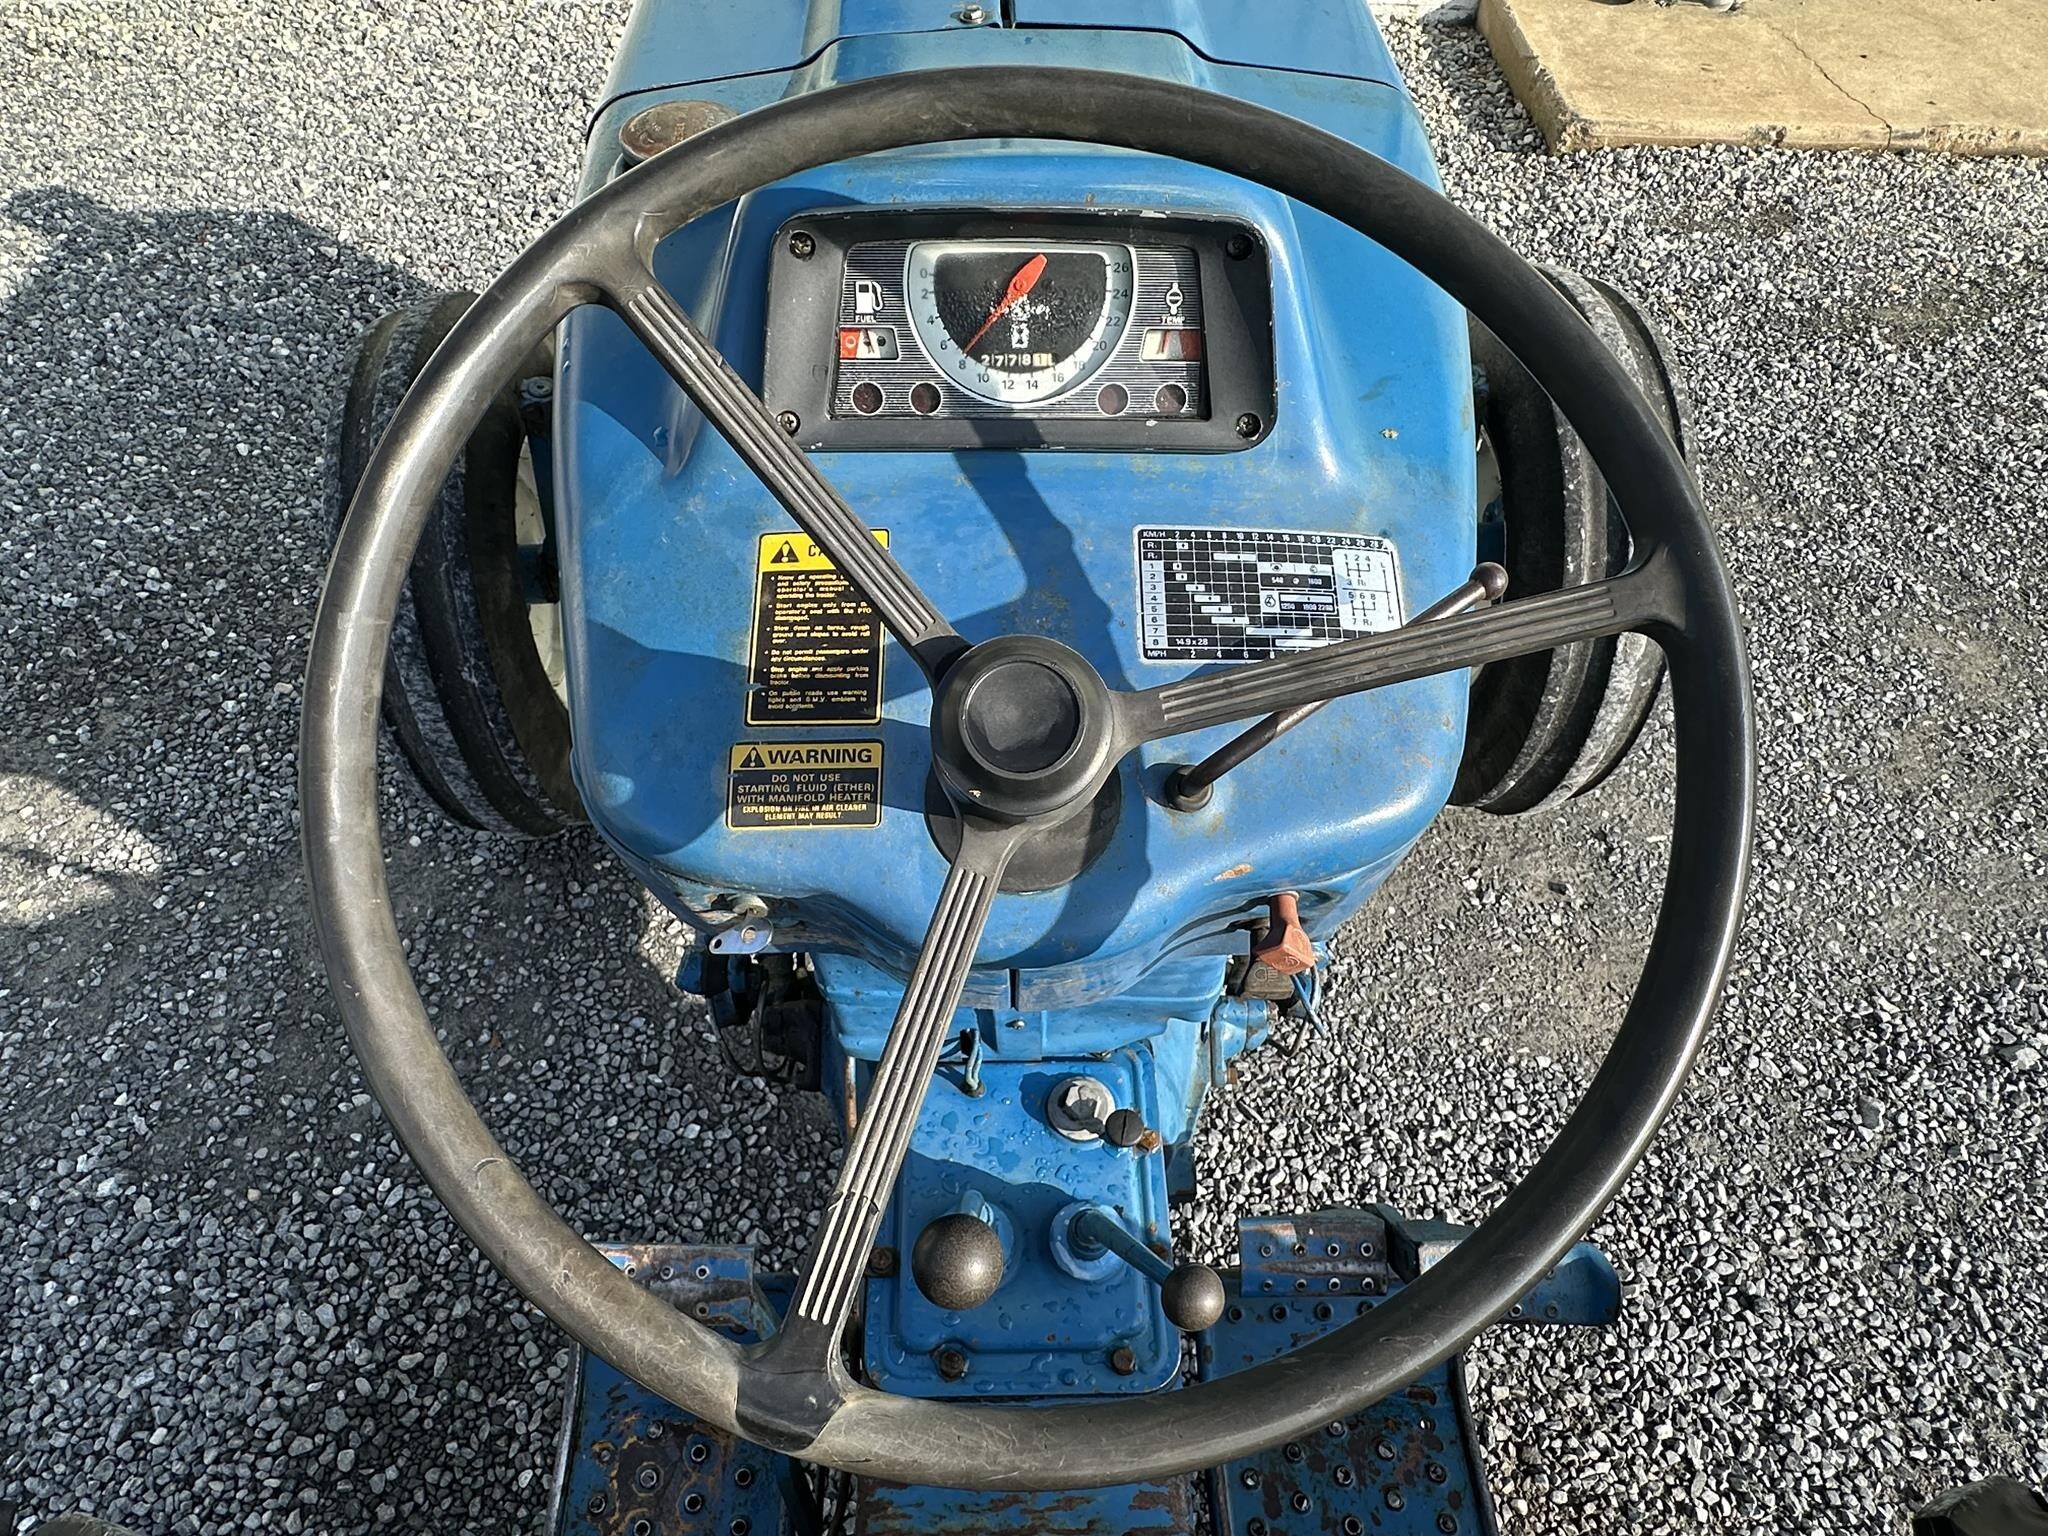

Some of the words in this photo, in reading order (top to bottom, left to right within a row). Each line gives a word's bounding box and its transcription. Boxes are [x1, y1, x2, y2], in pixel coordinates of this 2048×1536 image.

[1113, 262, 1129, 273] 26
[920, 268, 928, 278] 0
[921, 289, 928, 299] 2
[1112, 289, 1128, 299] 24
[855, 315, 876, 323] FUEL
[927, 315, 934, 325] 4
[1106, 317, 1120, 327] 22
[1160, 316, 1185, 325] TEMP
[940, 340, 947, 350] 6
[1094, 341, 1107, 351] 20
[959, 360, 966, 369] 8
[977, 373, 989, 382] 10
[1052, 373, 1064, 382] 16
[1002, 380, 1015, 389] 12
[1026, 380, 1038, 389] 14
[768, 748, 872, 764] WARNING
[772, 775, 787, 783] DO
[793, 774, 815, 782] NOT
[738, 785, 790, 793] STARTING
[797, 784, 828, 792] FLUID
[833, 783, 875, 792] (ETHER)
[737, 795, 765, 803] WITH
[769, 794, 825, 802] MANIFOLD
[830, 793, 873, 801] HEATER.
[765, 813, 795, 821] ELEMENT
